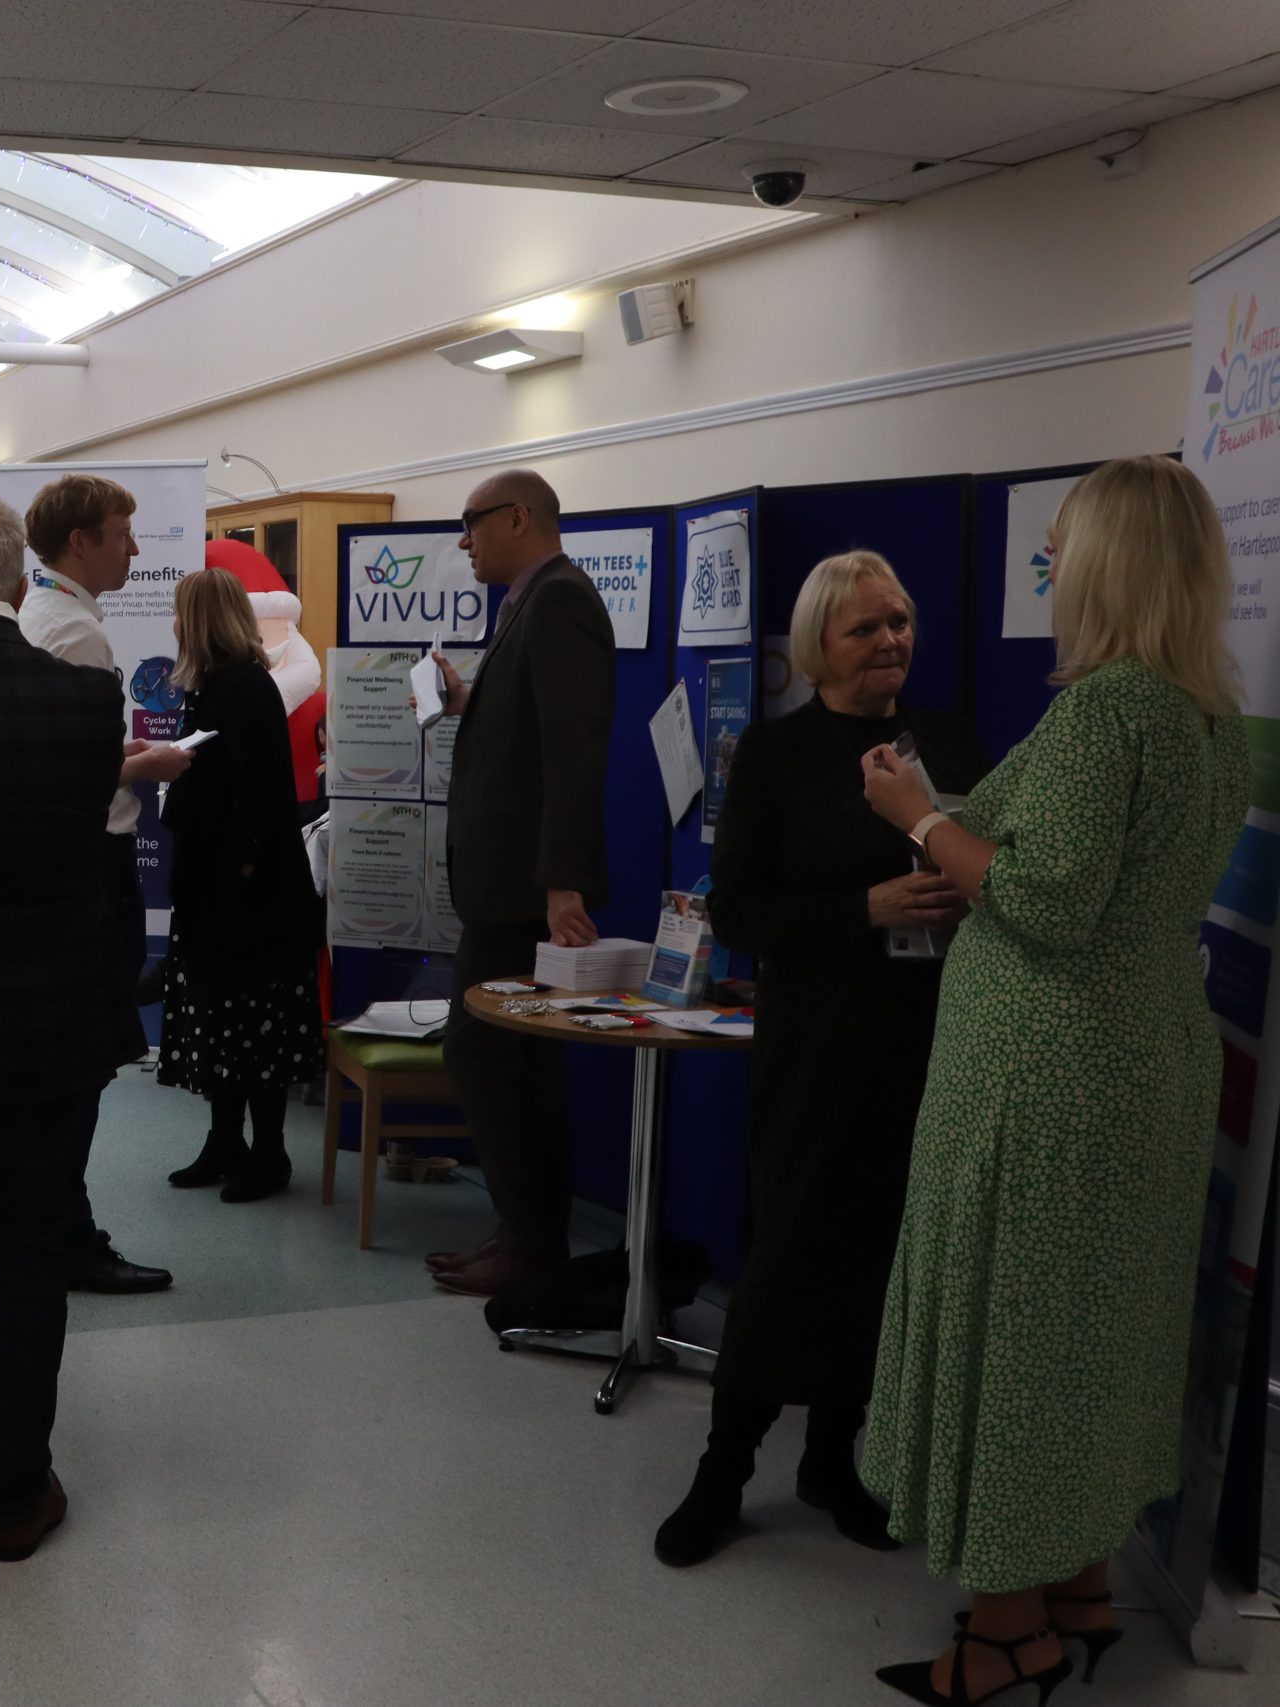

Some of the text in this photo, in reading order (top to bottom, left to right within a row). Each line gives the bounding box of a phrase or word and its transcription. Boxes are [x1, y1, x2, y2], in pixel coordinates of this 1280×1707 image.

[1219, 426, 1257, 455] Because
[1249, 500, 1260, 518] to
[570, 555, 632, 572] ORTH TEES
[719, 549, 734, 568] BLUE
[597, 577, 637, 592] EPOOL
[721, 569, 740, 588] LIGHT
[135, 590, 165, 598] benefits
[1237, 583, 1249, 595] we
[145, 600, 174, 609] helping
[356, 590, 481, 631] vivup
[1240, 606, 1252, 620] see
[390, 652, 409, 662] NTH
[347, 676, 403, 685] Financial Wellbeing
[363, 686, 387, 694] Support
[710, 706, 746, 719] START SAVING
[143, 716, 176, 725] Cycle to
[148, 726, 171, 735] Work
[392, 806, 411, 816] NTH
[376, 829, 405, 838] Wellbeing
[136, 837, 159, 850] the
[365, 838, 389, 846] Support
